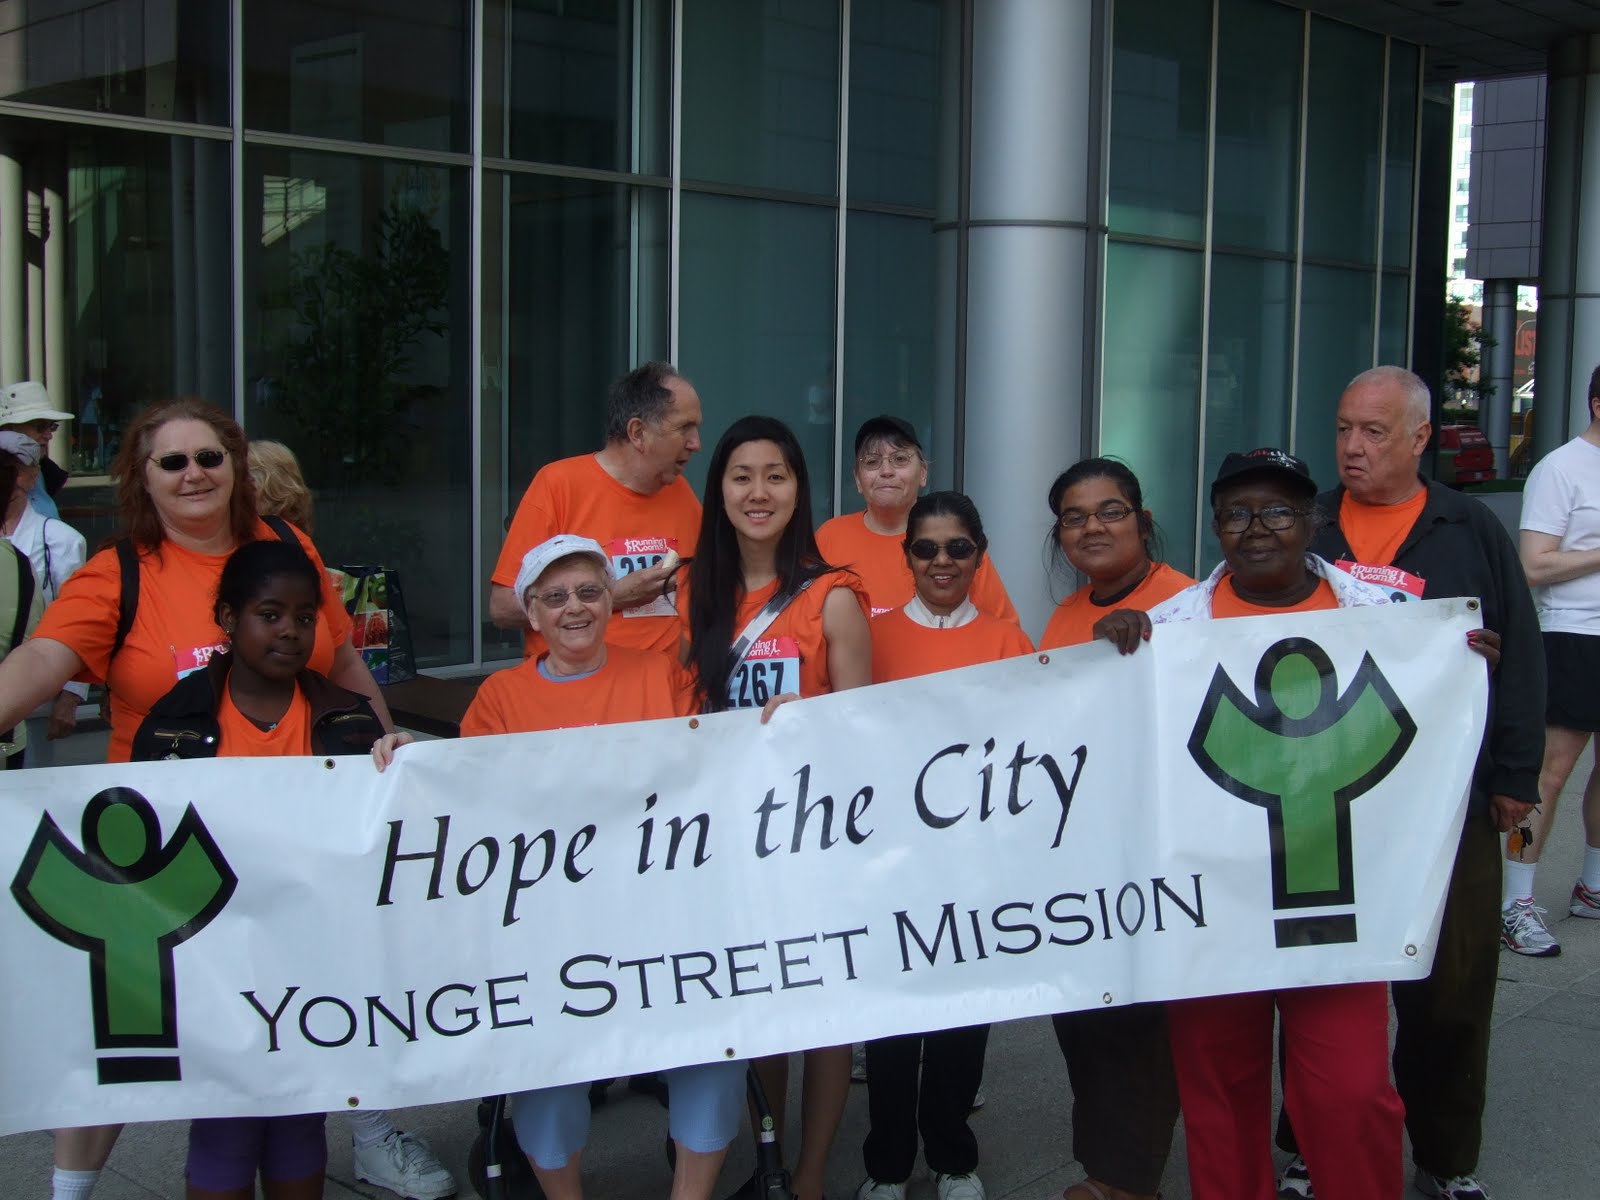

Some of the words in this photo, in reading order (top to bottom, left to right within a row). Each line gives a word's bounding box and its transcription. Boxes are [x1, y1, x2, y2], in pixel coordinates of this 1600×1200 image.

[1355, 565, 1398, 580] Running
[377, 815, 597, 928] Hope
[637, 792, 712, 875] in
[755, 764, 875, 858] the
[913, 737, 1088, 849] City
[239, 971, 535, 1053] YONGE
[560, 925, 870, 1018] STREET
[893, 874, 1208, 972] MISSION
